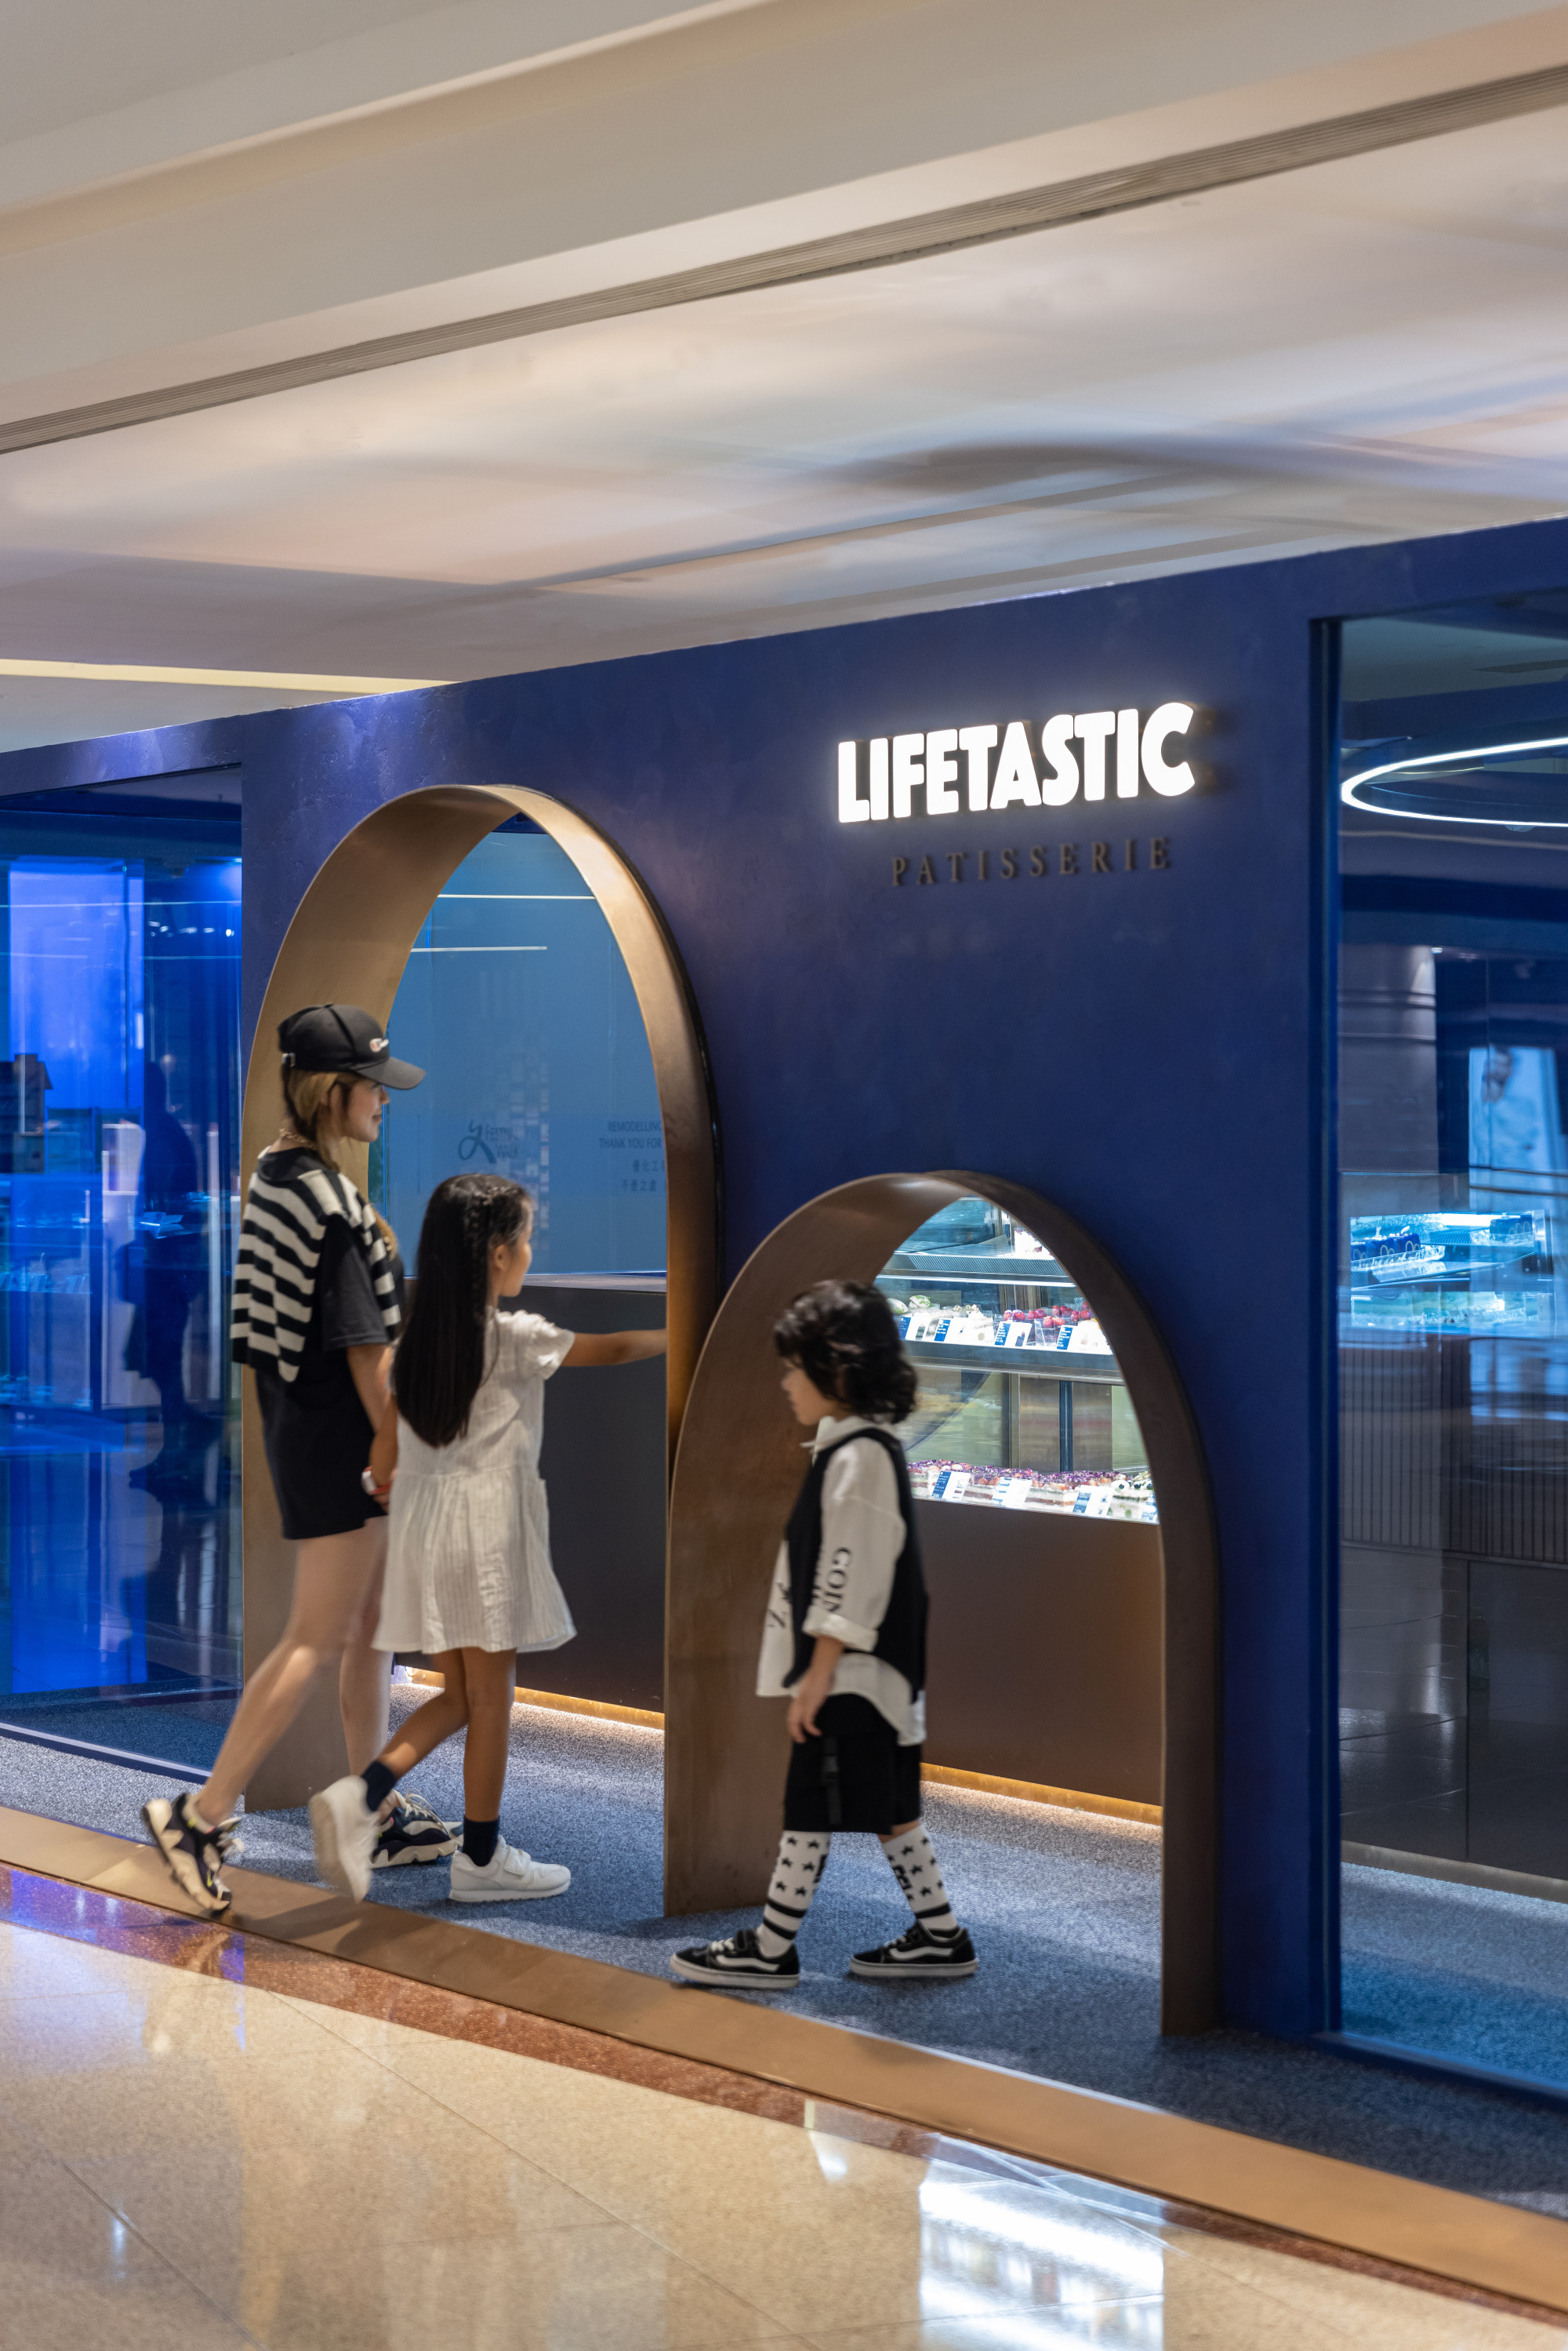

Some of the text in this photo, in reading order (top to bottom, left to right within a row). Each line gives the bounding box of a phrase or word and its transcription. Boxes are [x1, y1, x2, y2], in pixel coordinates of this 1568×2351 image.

[837, 702, 1196, 823] LIFETASTIC
[891, 837, 1171, 887] PATISSERIE
[599, 1138, 626, 1149] THANK
[627, 1138, 645, 1149] YOU
